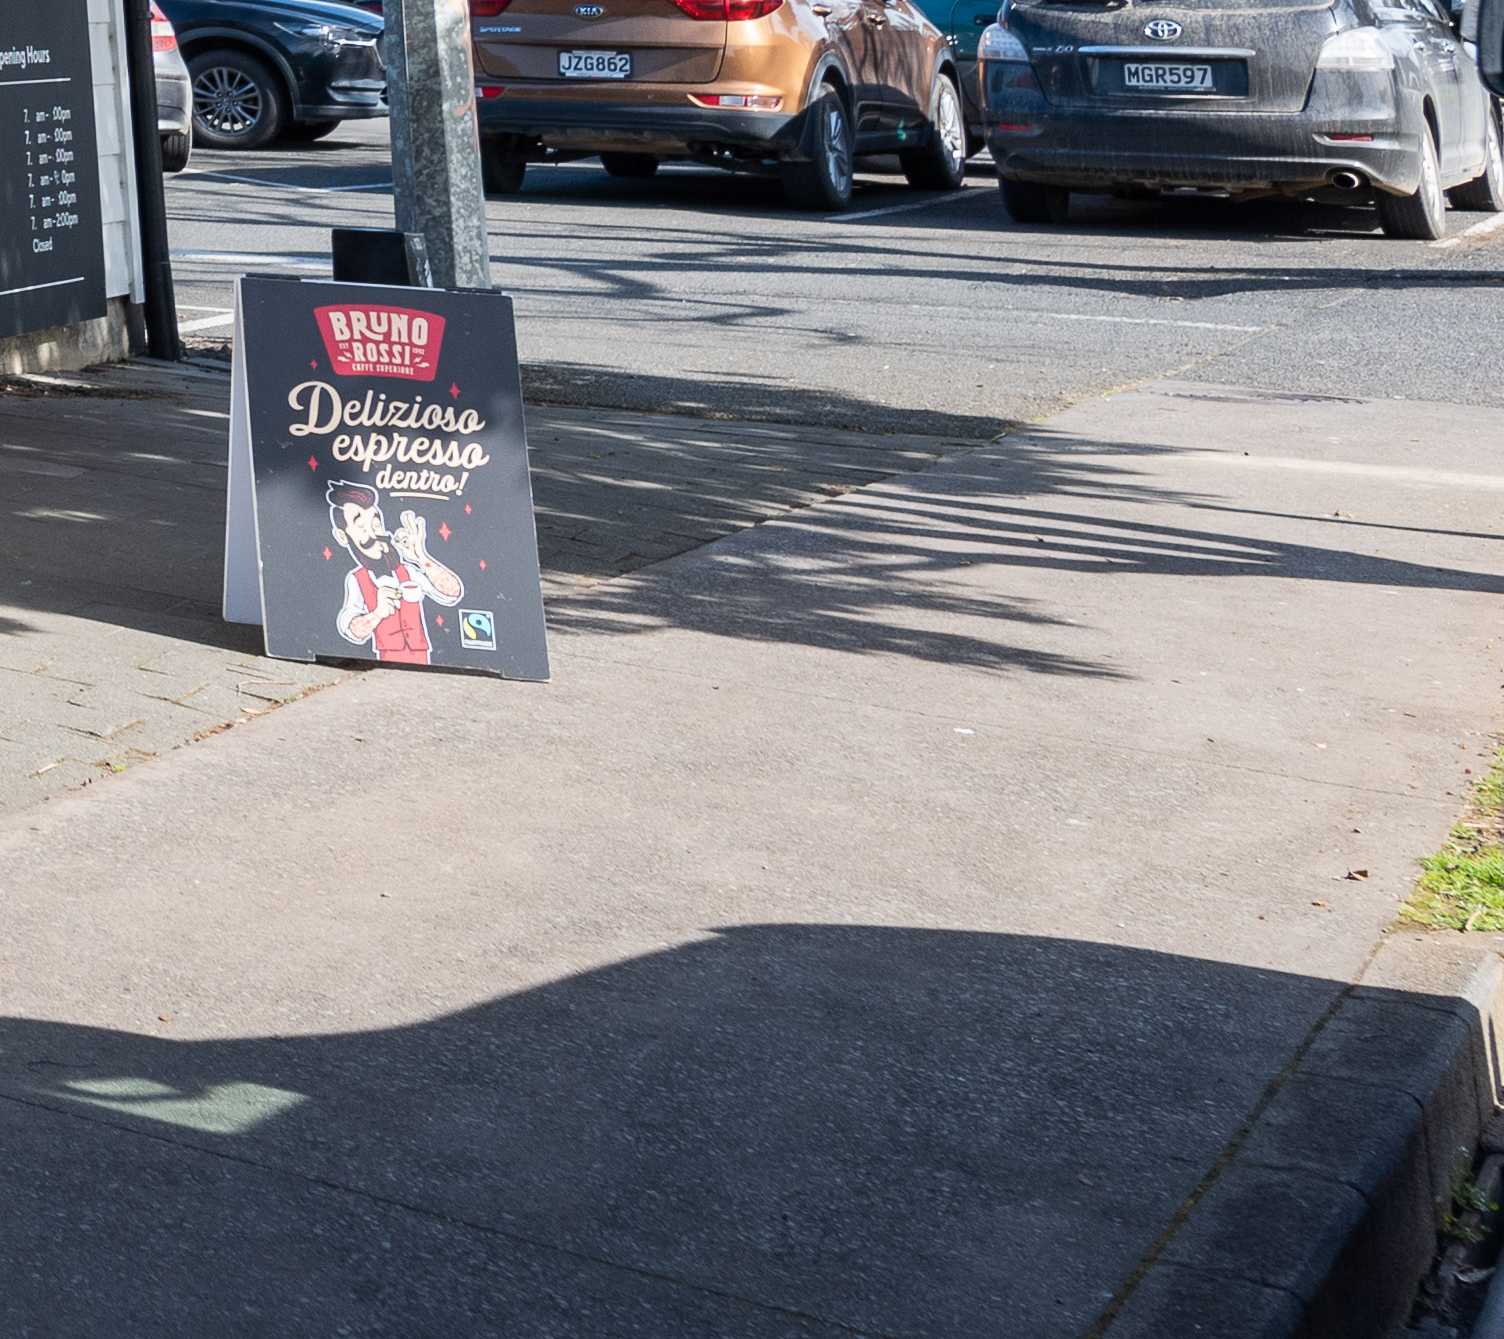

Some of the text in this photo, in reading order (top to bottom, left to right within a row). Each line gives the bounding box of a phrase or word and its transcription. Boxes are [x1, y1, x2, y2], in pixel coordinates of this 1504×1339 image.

[580, 7, 598, 15] KIA
[26, 45, 50, 64] Hours
[561, 55, 629, 72] JZG862
[1127, 66, 1209, 85] MGR597
[33, 236, 53, 253] Closed
[328, 311, 428, 346] BRUNO
[352, 341, 410, 365] ROSSI
[288, 380, 486, 437] Delizioso
[333, 432, 489, 472] espresso
[376, 463, 469, 496] dentro!
